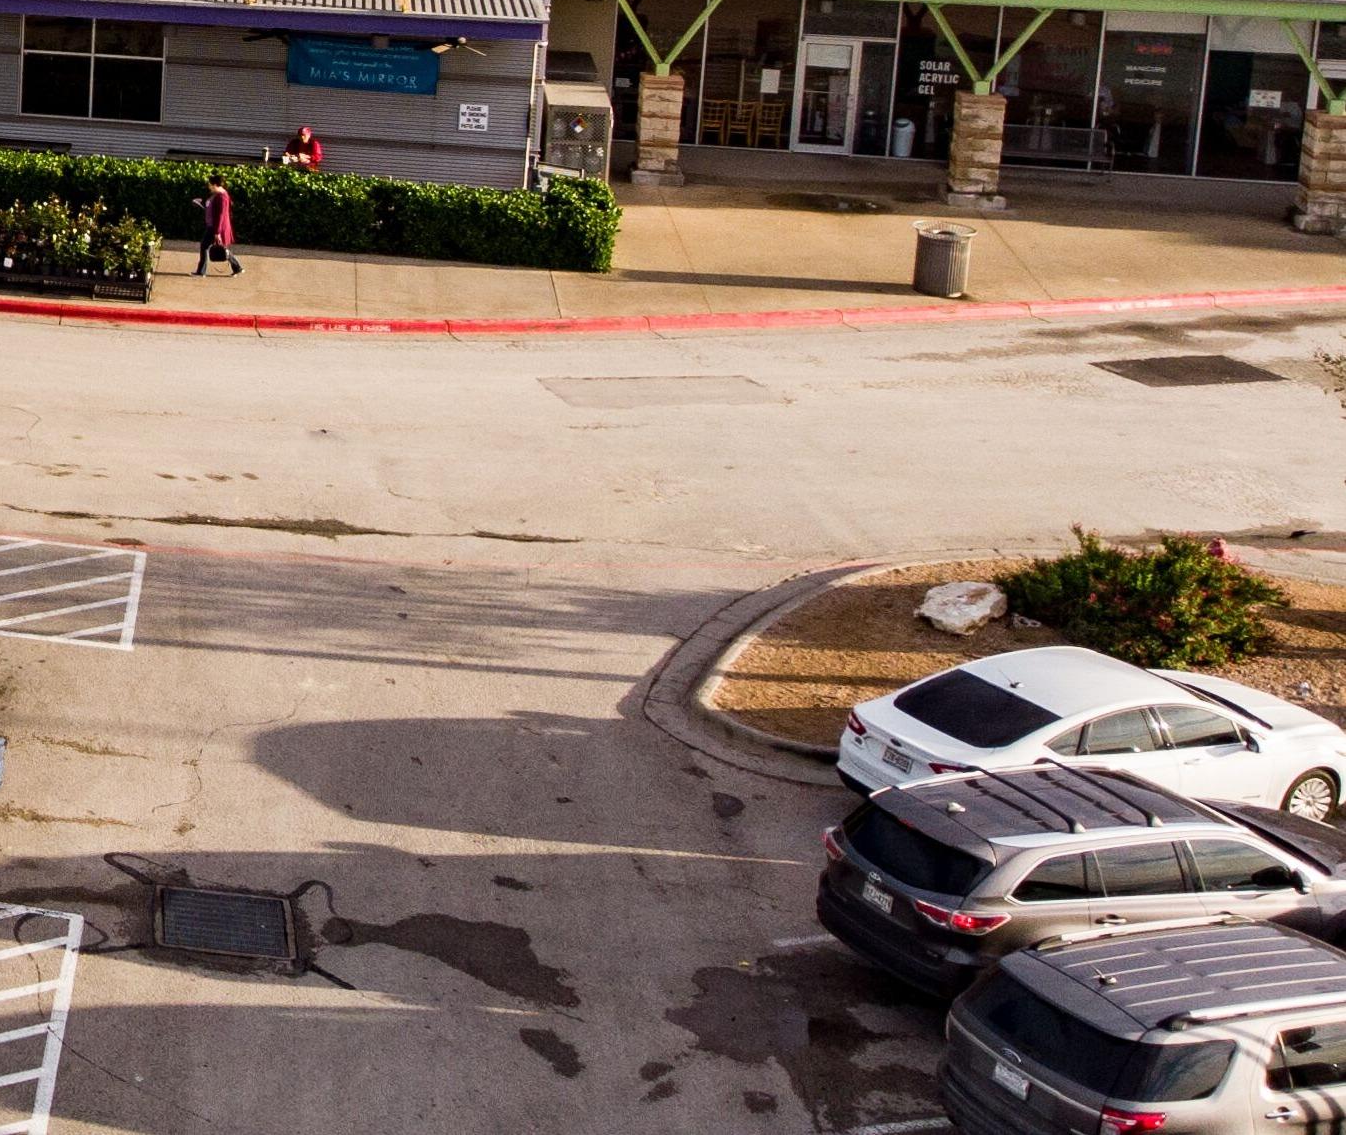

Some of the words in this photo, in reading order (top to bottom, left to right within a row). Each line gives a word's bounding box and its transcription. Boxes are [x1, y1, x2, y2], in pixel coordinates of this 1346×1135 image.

[919, 60, 951, 71] SOLAR
[309, 66, 350, 81] MIA'S
[357, 72, 418, 86] MIRROR
[919, 72, 960, 84] ACRYLIC
[918, 84, 935, 95] GEL
